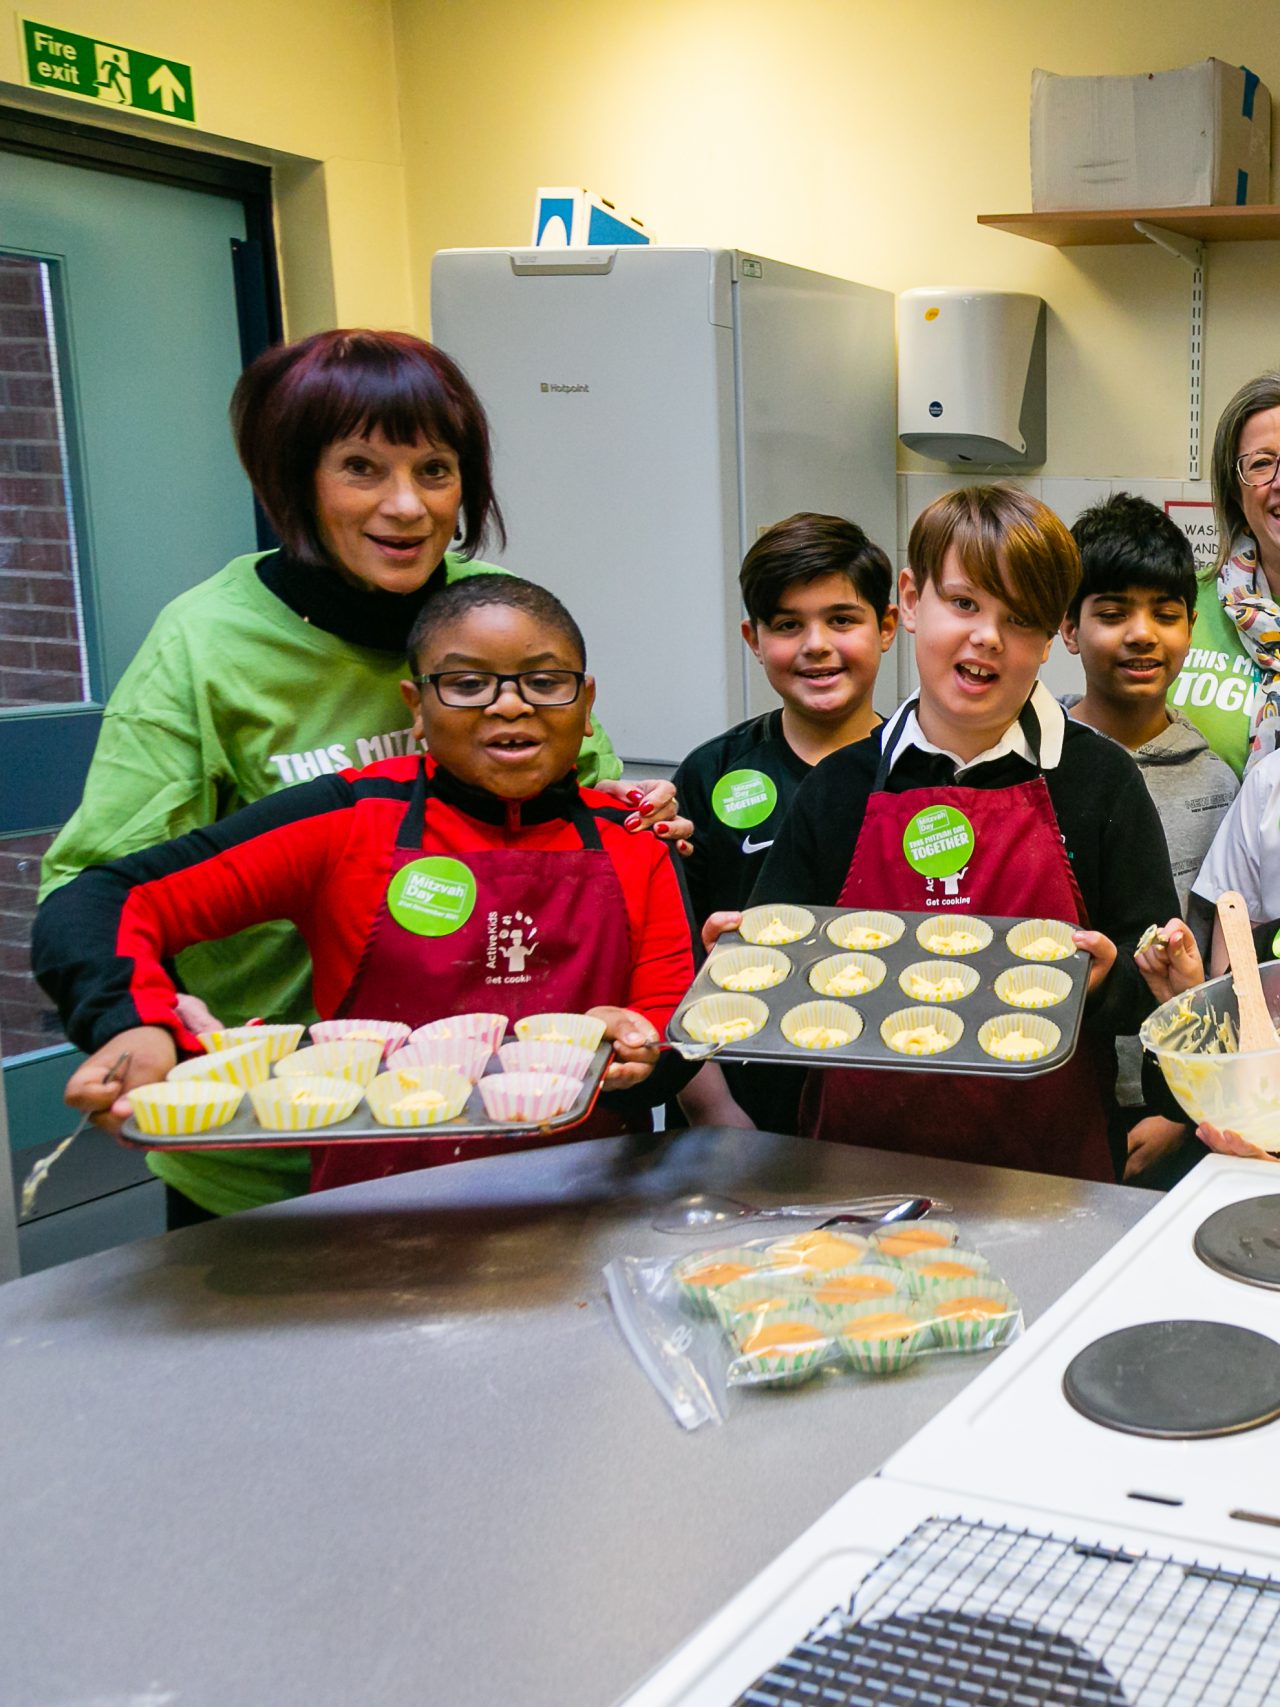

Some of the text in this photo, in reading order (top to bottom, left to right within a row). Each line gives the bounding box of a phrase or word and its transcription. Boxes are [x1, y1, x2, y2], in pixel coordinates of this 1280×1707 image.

[33, 31, 78, 61] Fire
[37, 61, 81, 85] exit
[550, 383, 590, 393] Hotpoint
[1193, 542, 1220, 556] AND
[1182, 647, 1230, 672] THIS
[268, 727, 429, 784] THIS MITZ
[911, 832, 970, 861] TOGETHER
[405, 884, 436, 904] Day
[410, 874, 465, 897] Mitzvah
[925, 896, 971, 906] Get cooking
